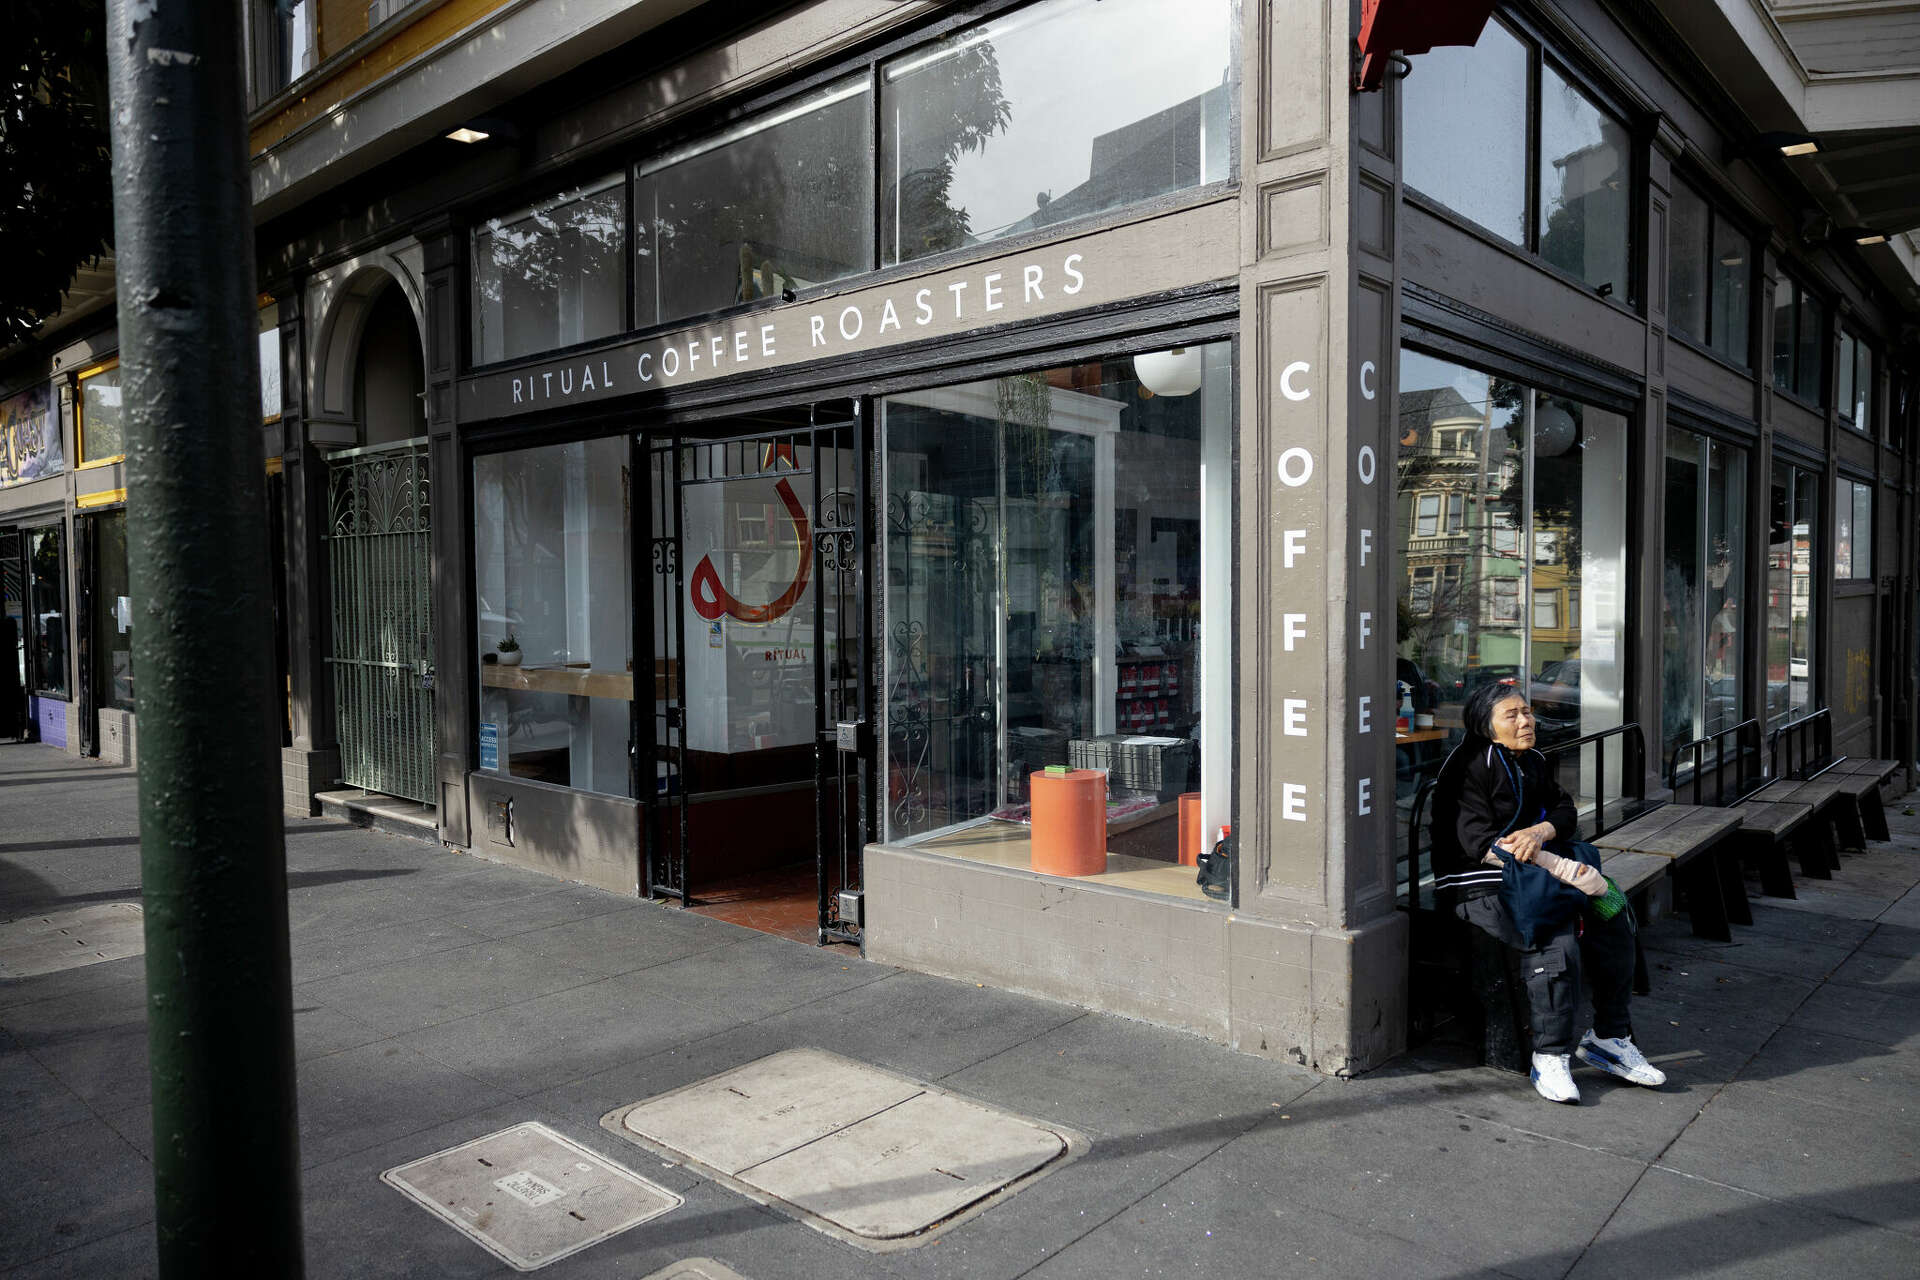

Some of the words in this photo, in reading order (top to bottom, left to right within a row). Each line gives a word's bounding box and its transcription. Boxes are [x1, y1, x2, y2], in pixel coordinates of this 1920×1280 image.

[511, 361, 614, 404] RITUAL
[637, 323, 777, 383] COFFEE
[810, 253, 1084, 347] ROASTERS
[764, 648, 807, 662] RITUAL
[1277, 360, 1314, 822] COFFEE
[1358, 360, 1376, 816] COFFEE
